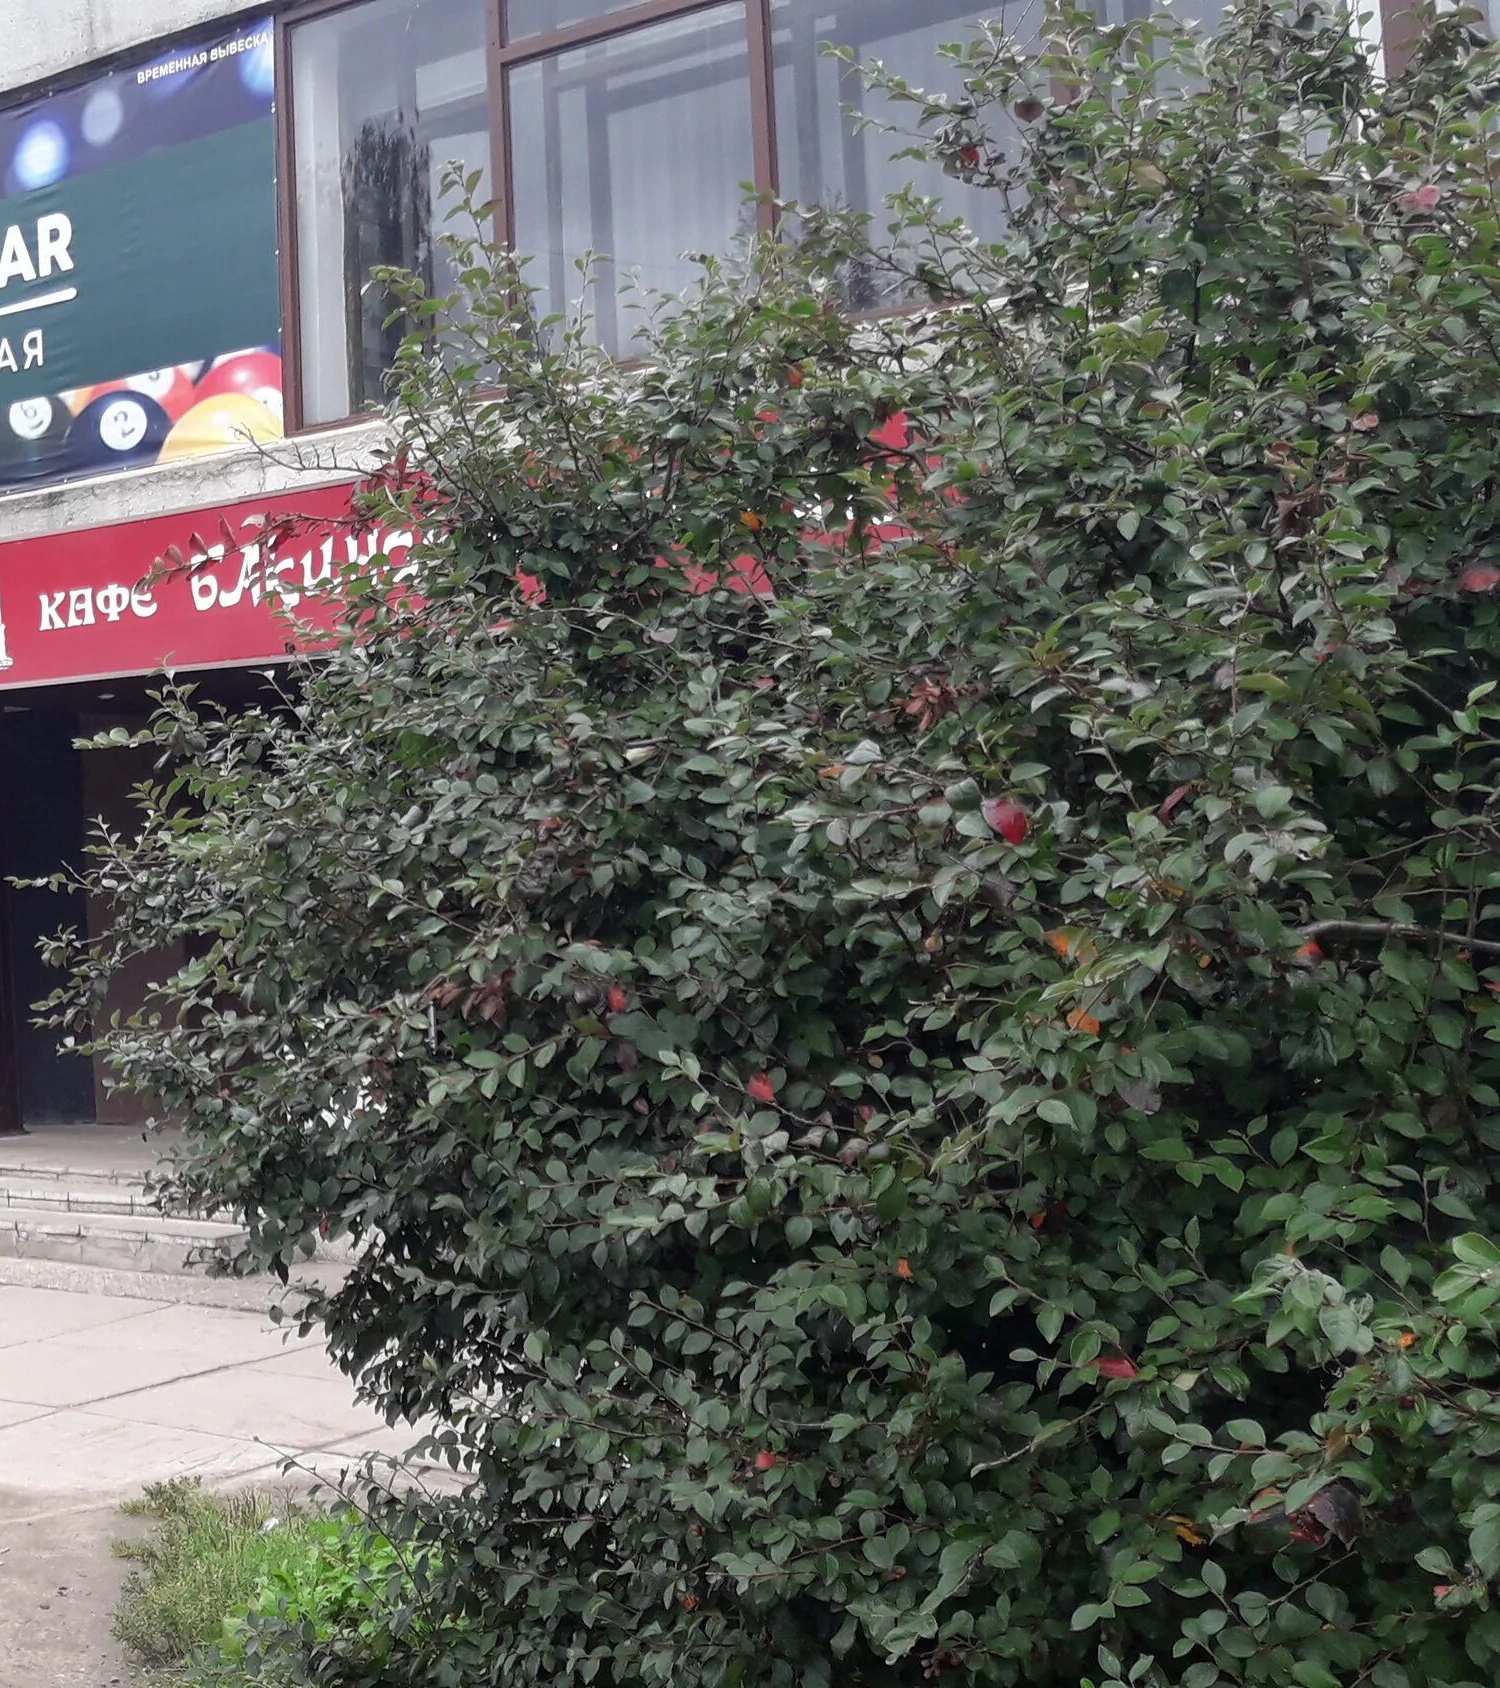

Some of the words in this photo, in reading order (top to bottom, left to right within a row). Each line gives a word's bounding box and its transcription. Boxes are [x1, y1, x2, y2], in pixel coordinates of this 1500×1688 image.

[137, 53, 207, 84] ВРЕМЕННАЯ
[210, 32, 269, 62] ВЫВЕСКА
[39, 578, 158, 631] КАФЕ
